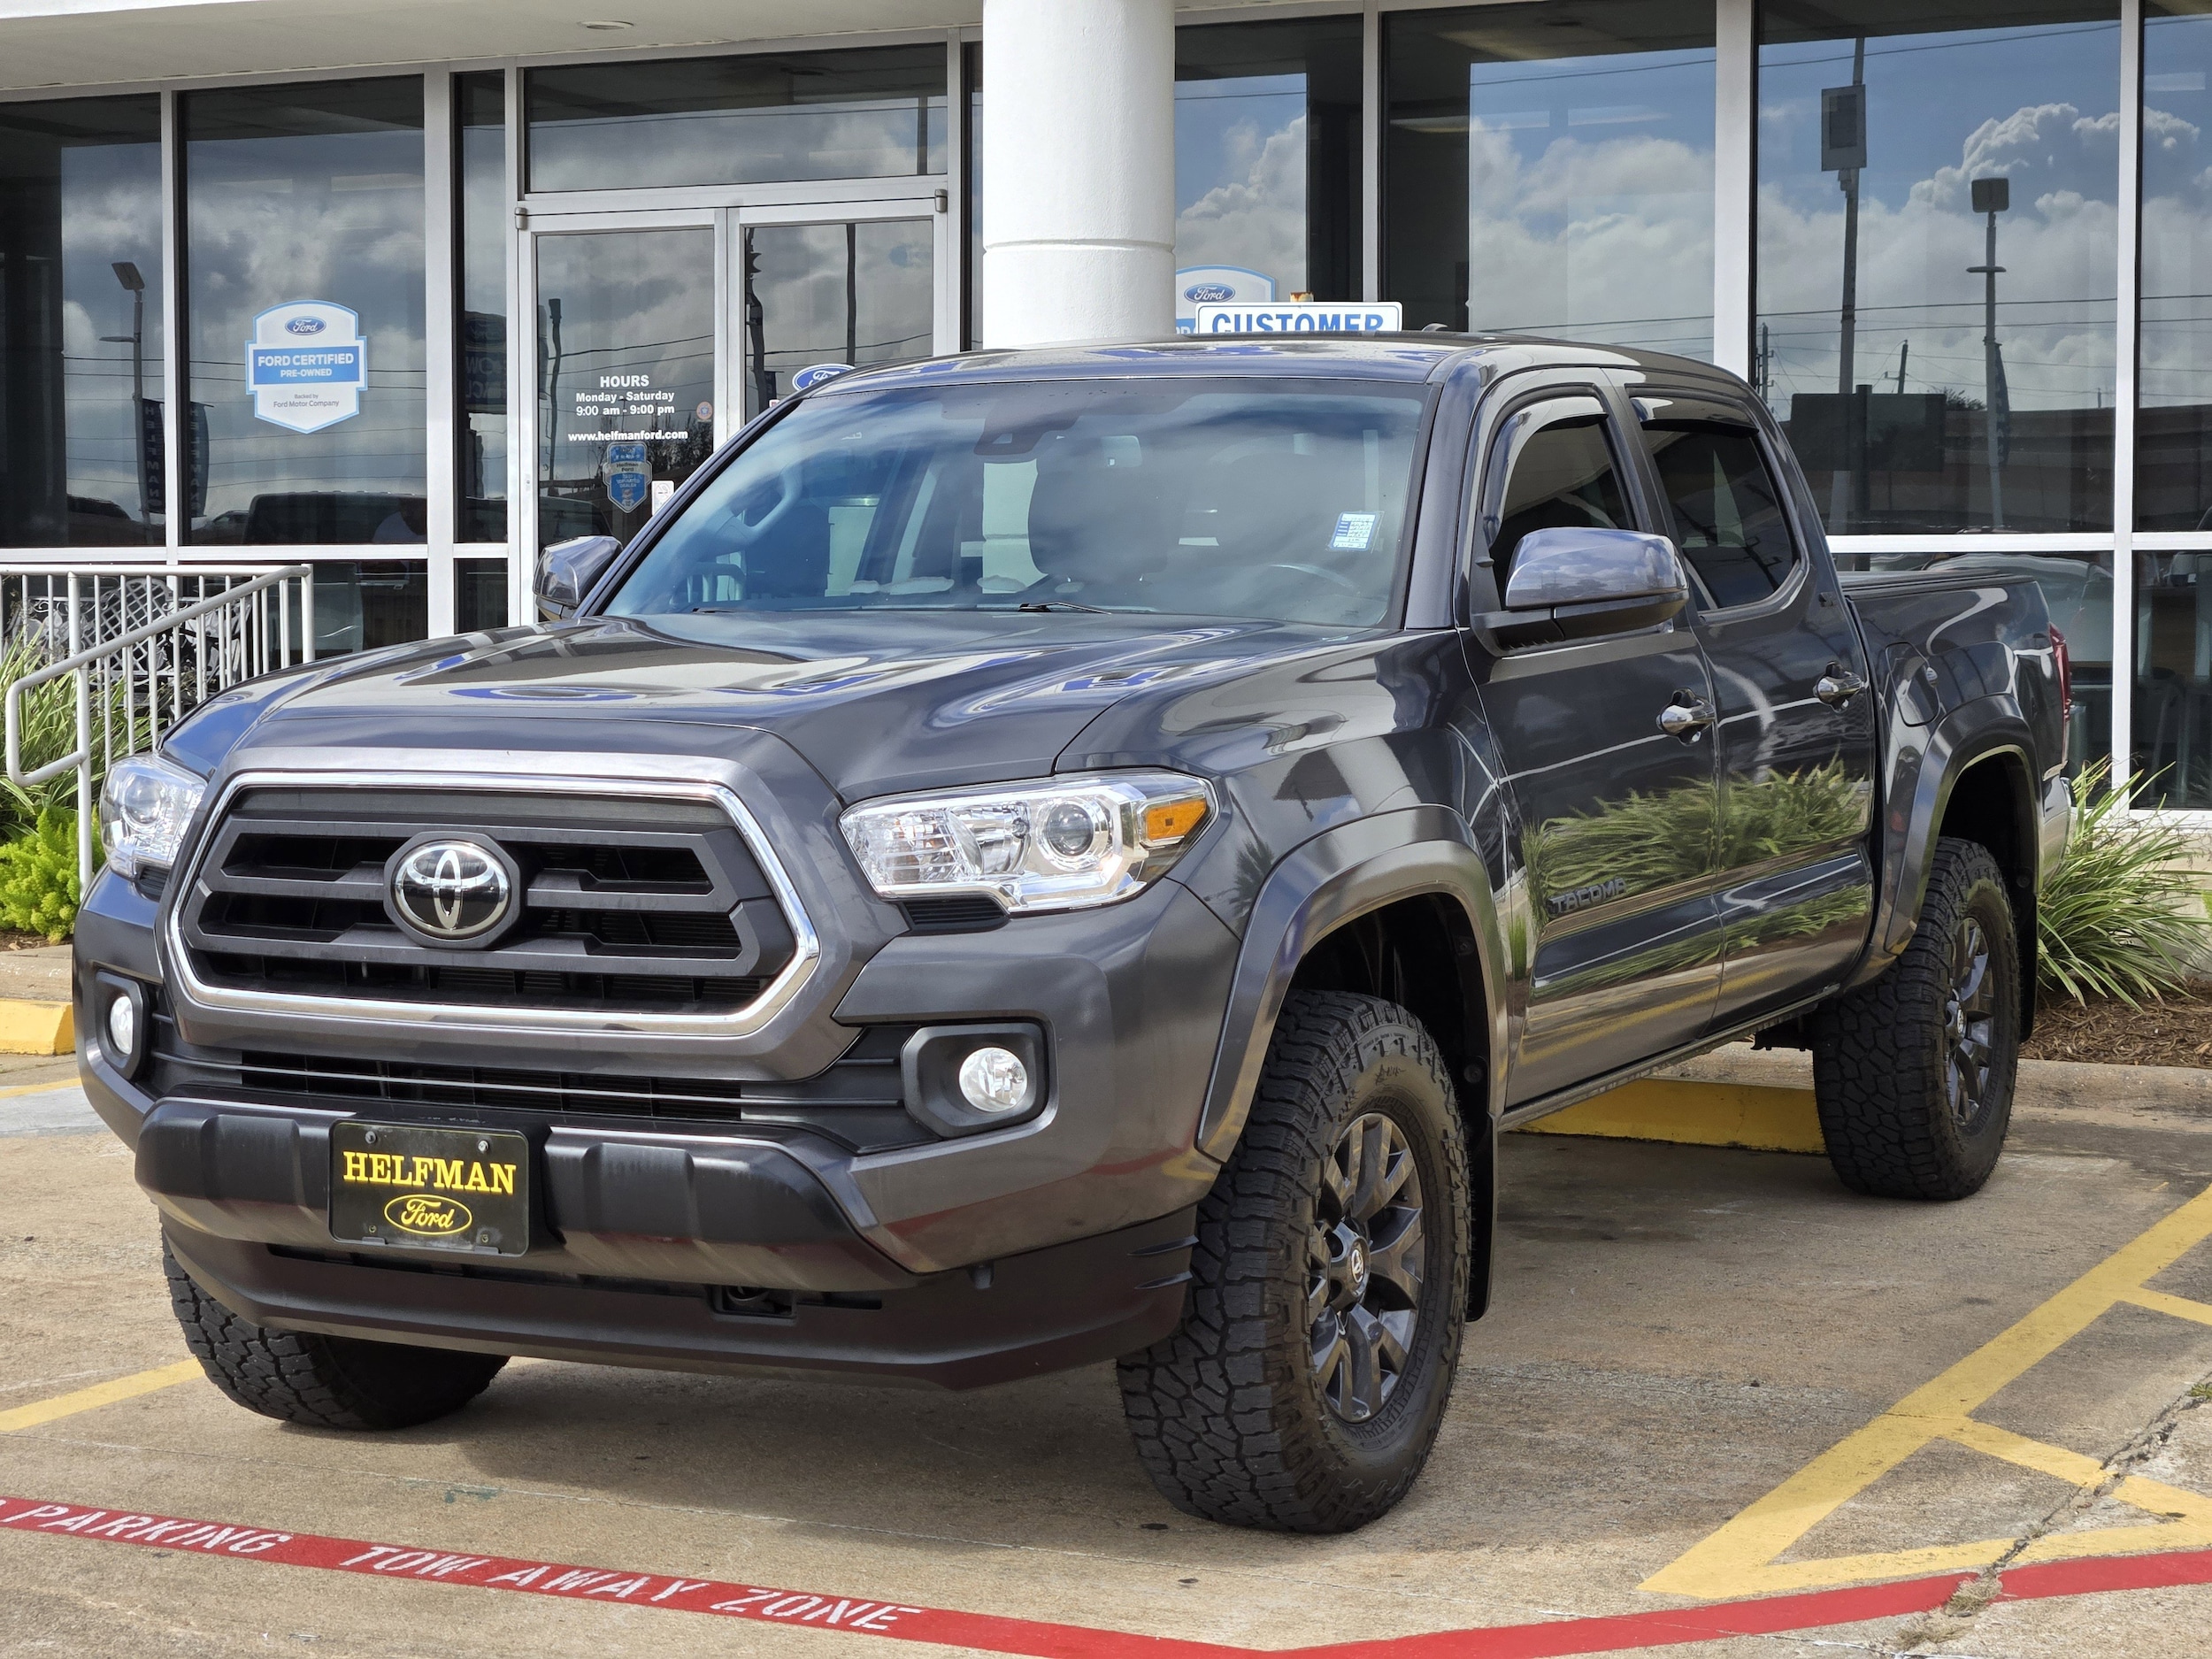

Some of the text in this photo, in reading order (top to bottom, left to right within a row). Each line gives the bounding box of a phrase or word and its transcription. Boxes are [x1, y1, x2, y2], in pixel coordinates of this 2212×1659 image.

[1194, 286, 1225, 302] Ford
[292, 319, 319, 333] Ford
[1212, 313, 1384, 334] CUSTOMER
[257, 353, 355, 367] FORD CERTIFIED
[280, 368, 333, 378] PRE-OWNED
[600, 374, 649, 388] HOURS
[576, 392, 618, 403] Monday
[626, 390, 675, 403] Saturday
[576, 405, 599, 416] 9:00
[603, 406, 620, 415] am
[630, 404, 655, 415] 9:00
[657, 404, 675, 416] pm
[568, 429, 688, 442] www.helfmanford.com
[1549, 876, 1627, 913] TACOMA
[342, 1151, 517, 1194] HELFMAN
[400, 1197, 456, 1228] Ford
[1, 1504, 923, 1631] PARKING TOW AWAY ZONE
